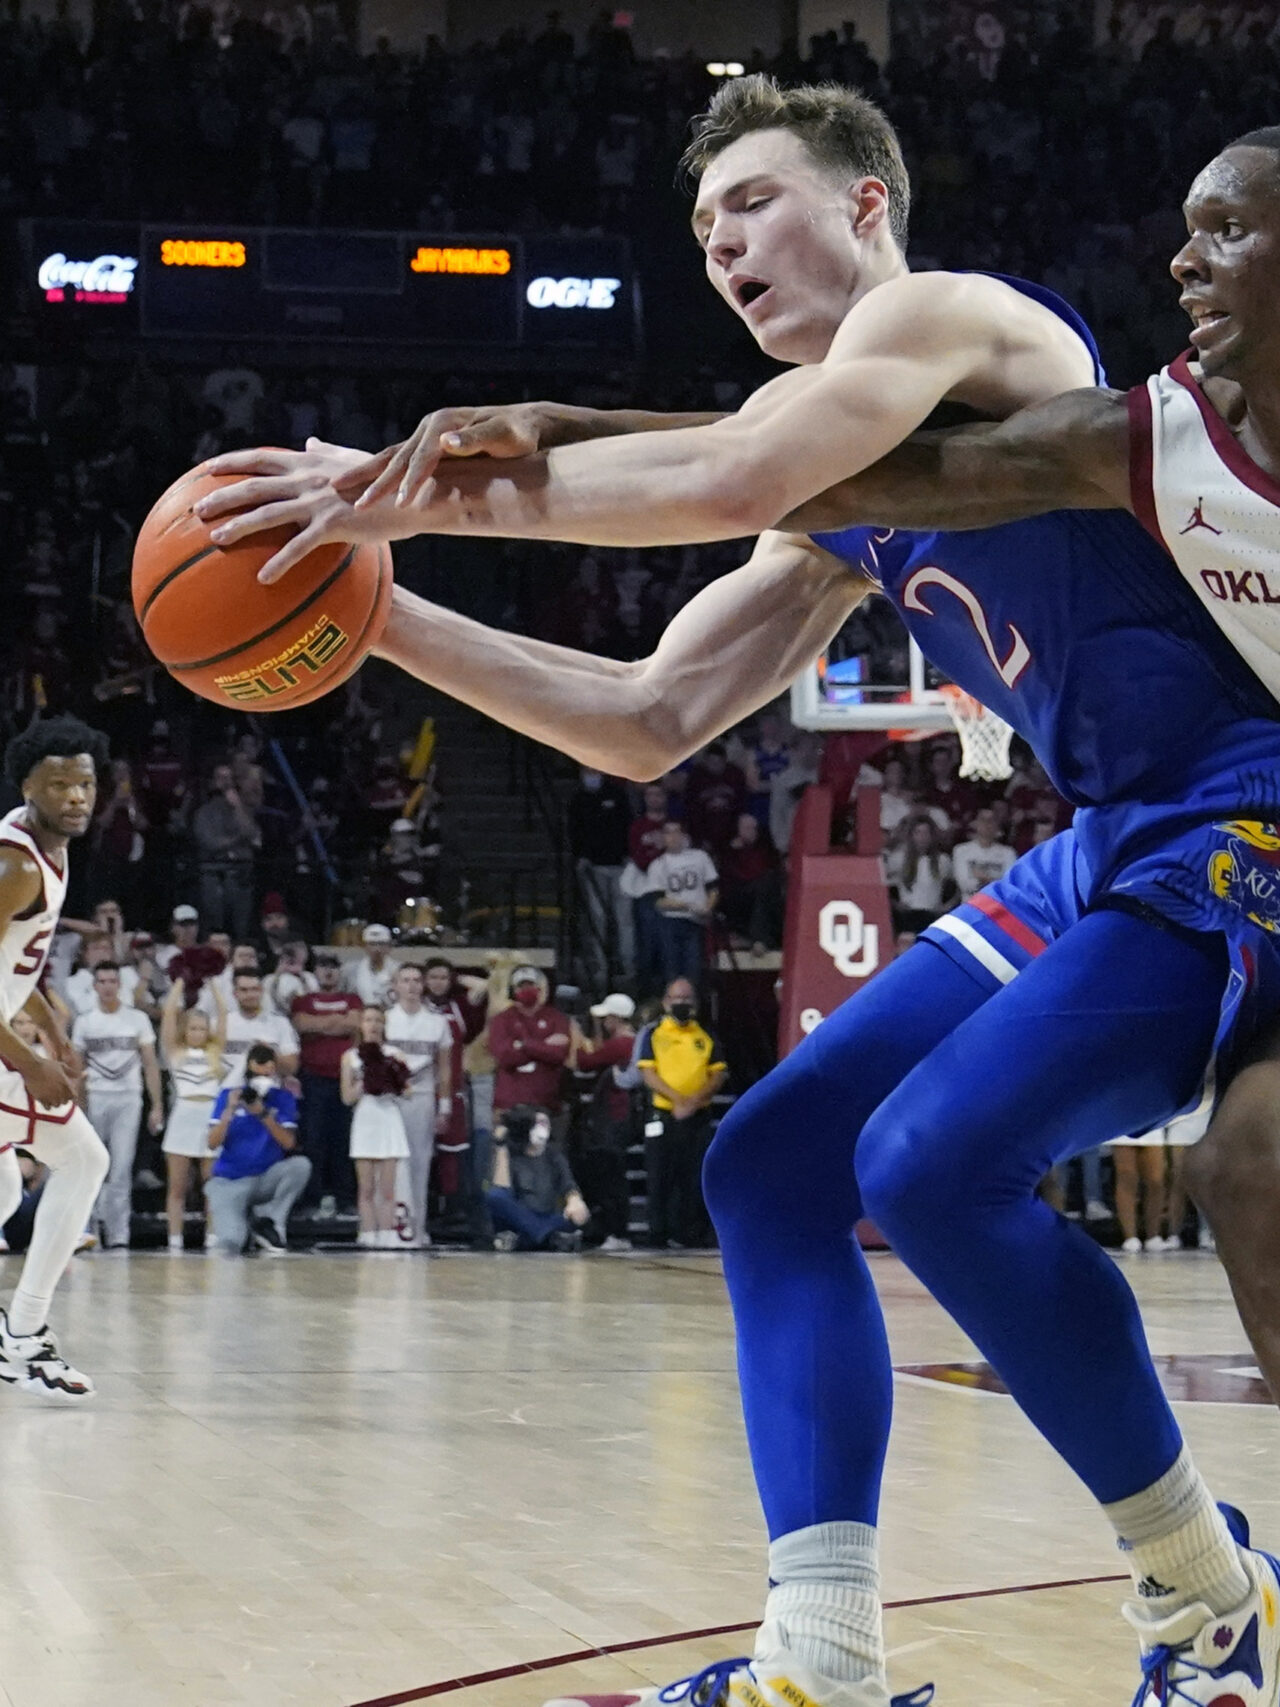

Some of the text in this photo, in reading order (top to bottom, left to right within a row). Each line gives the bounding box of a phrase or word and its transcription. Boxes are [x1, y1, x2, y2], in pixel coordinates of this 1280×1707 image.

[214, 614, 329, 684] CHAMPIONSHIP
[219, 621, 349, 701] ELITE
[904, 566, 1030, 689] 2
[1244, 866, 1276, 898] KU
[819, 900, 878, 978] OU
